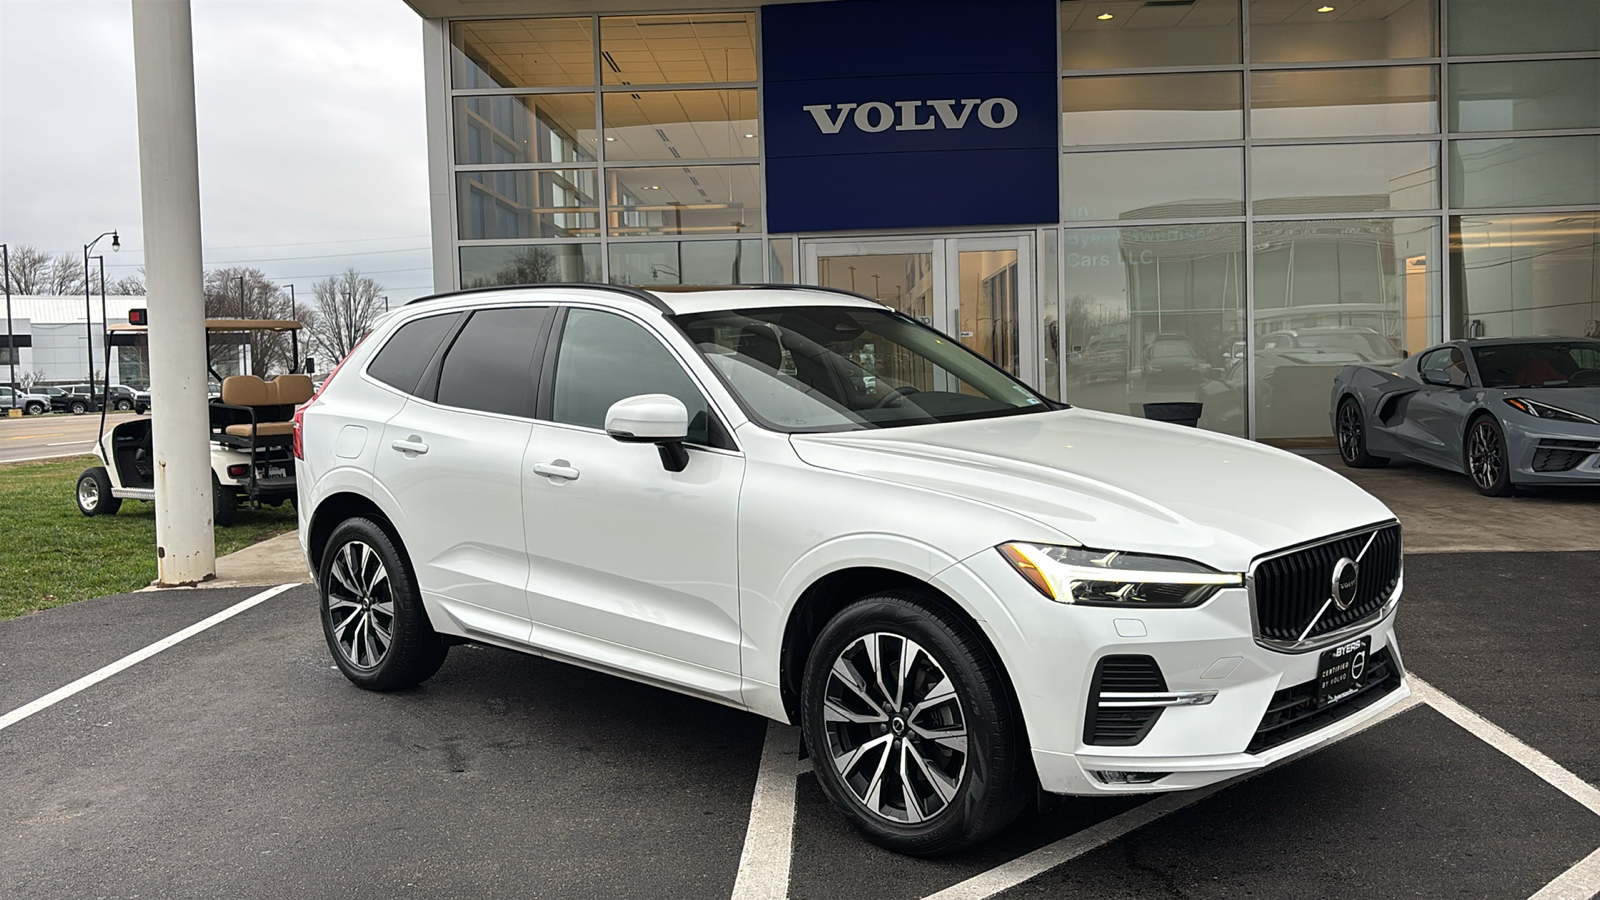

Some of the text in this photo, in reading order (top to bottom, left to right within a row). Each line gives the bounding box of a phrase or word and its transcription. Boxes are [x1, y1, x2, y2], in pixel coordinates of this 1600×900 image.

[802, 97, 1019, 135] VOLVO
[1067, 249, 1154, 267] Cars LLC
[1335, 640, 1361, 657] BYERS
[1322, 661, 1349, 678] CERTIFIED
[1321, 680, 1329, 689] BY
